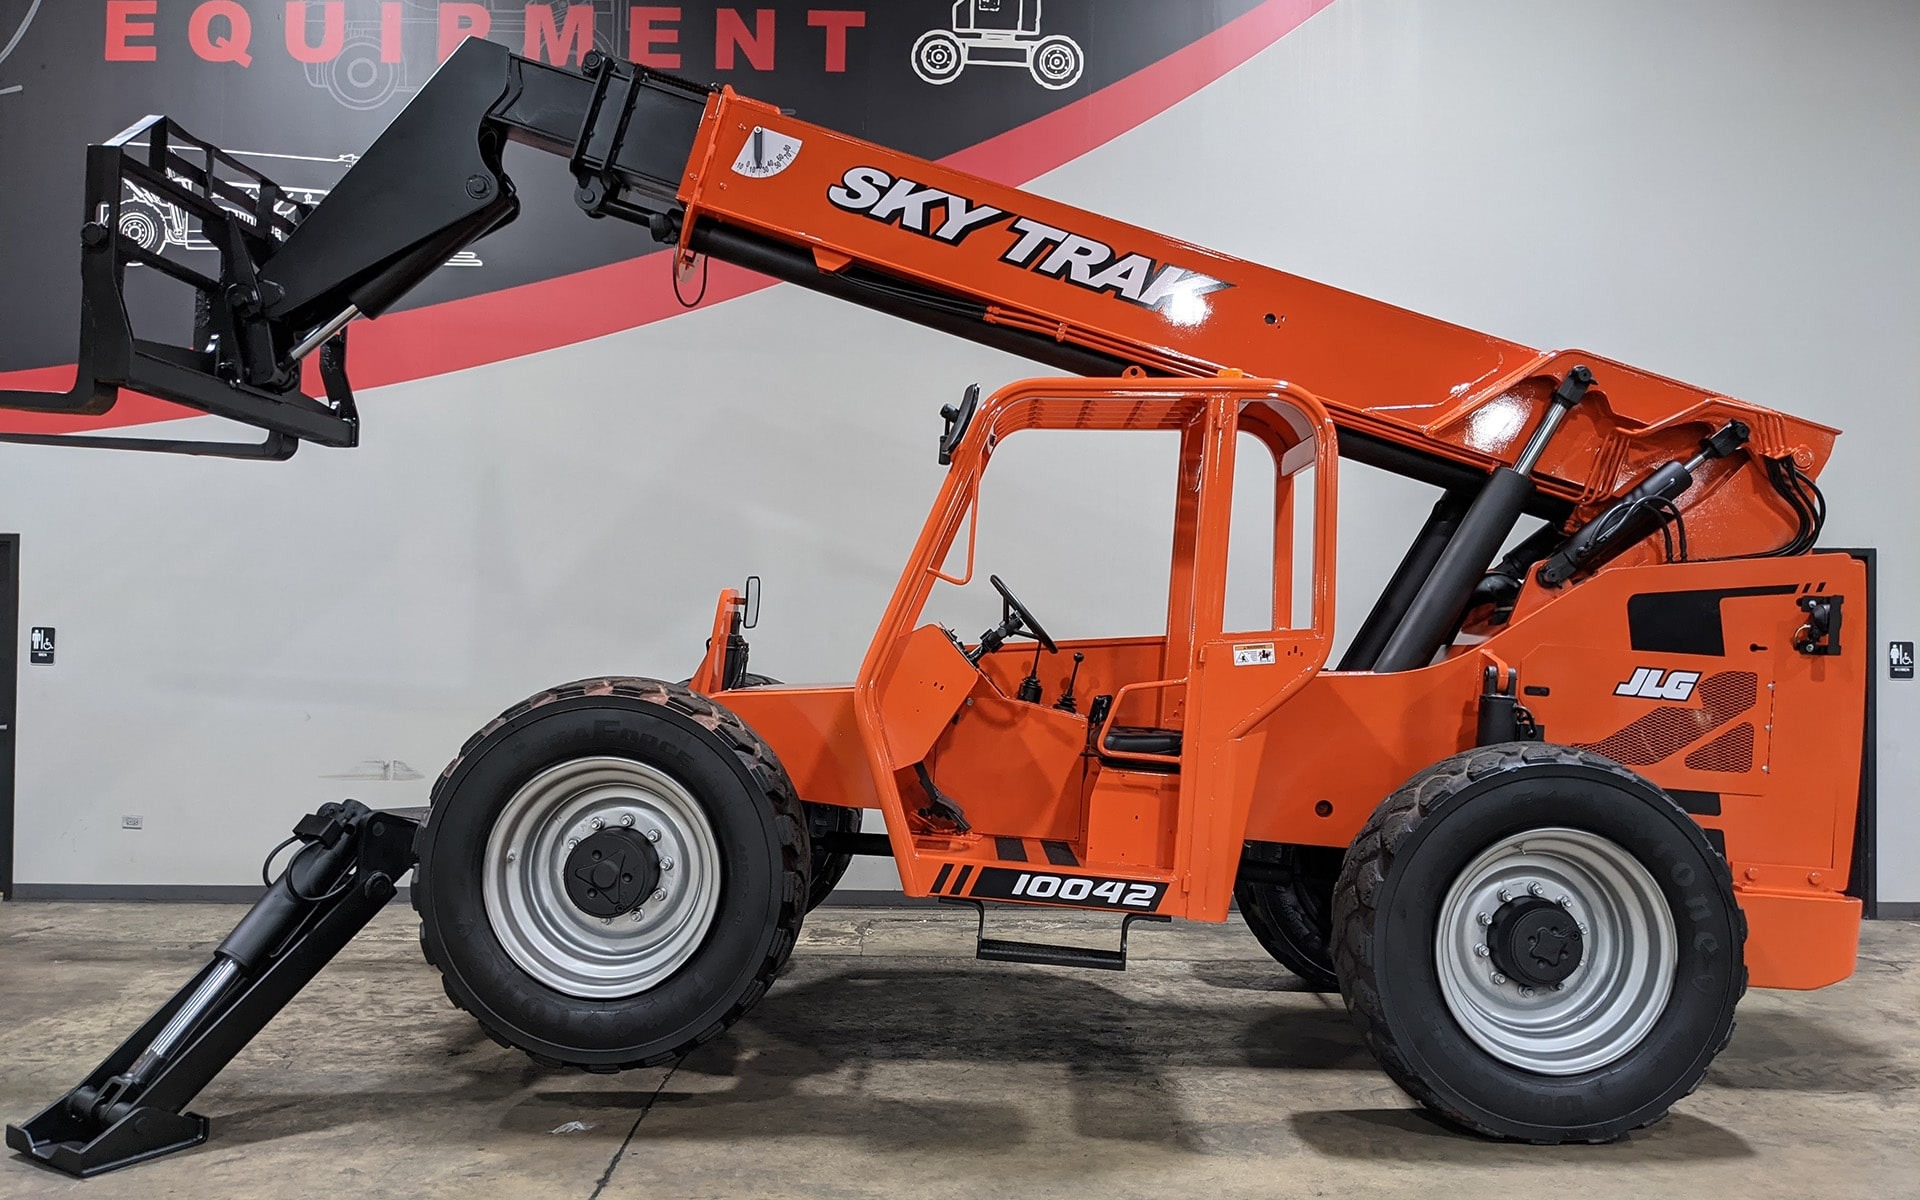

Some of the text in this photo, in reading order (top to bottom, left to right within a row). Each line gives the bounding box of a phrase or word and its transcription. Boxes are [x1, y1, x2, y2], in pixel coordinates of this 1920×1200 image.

[104, 0, 866, 72] EQUIPMENT
[827, 165, 1230, 312] SKY TRAK
[1614, 667, 1702, 701] JLG
[1011, 873, 1157, 907] 10042
